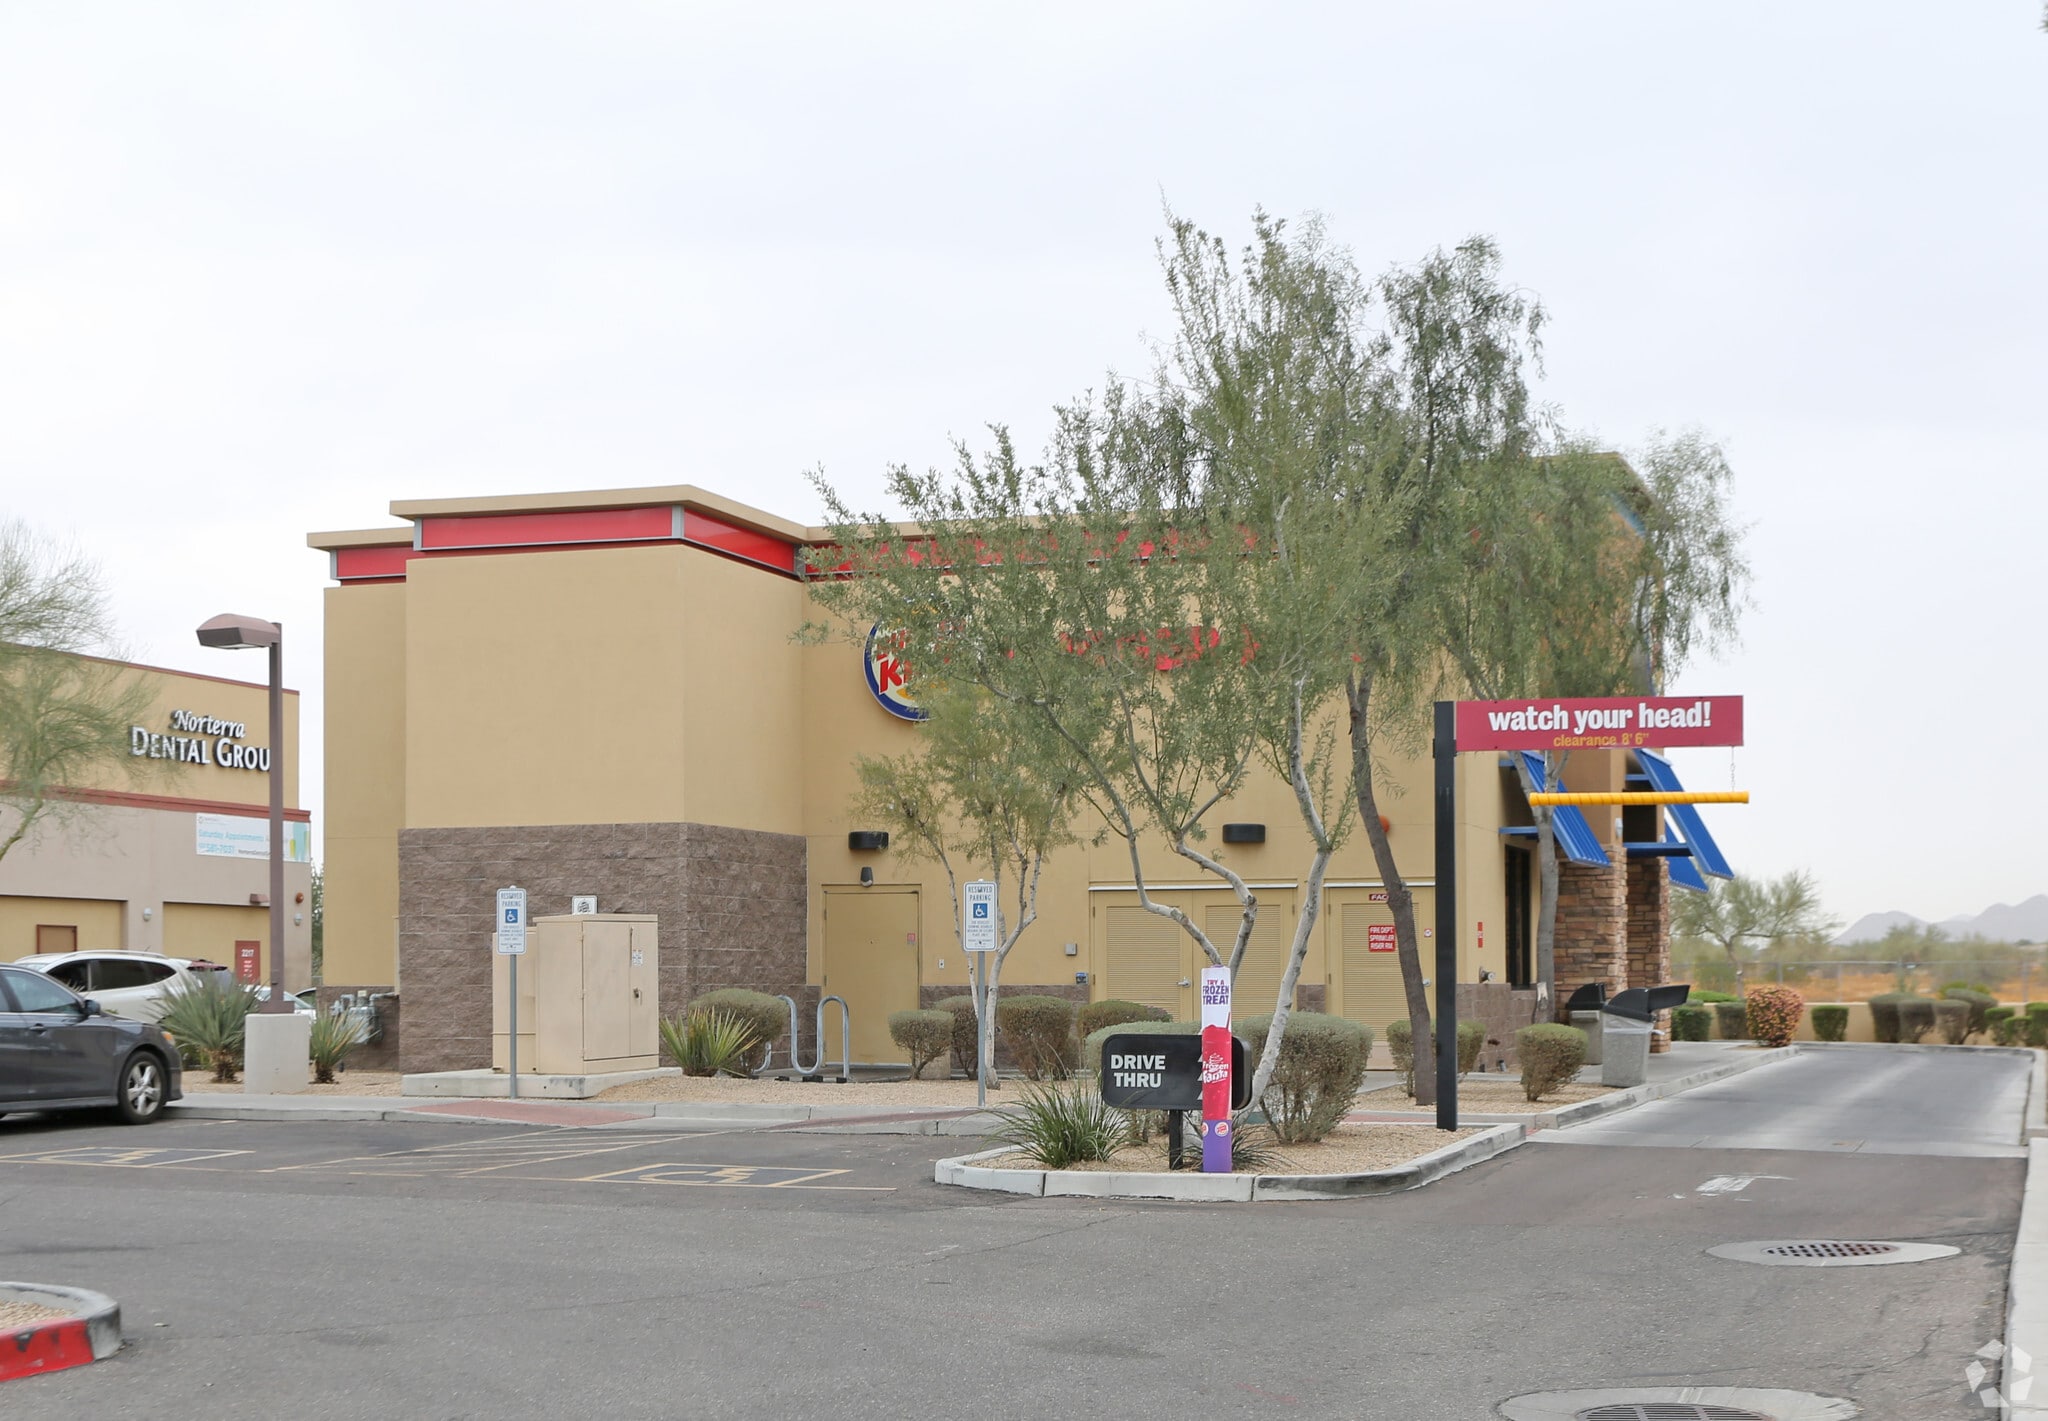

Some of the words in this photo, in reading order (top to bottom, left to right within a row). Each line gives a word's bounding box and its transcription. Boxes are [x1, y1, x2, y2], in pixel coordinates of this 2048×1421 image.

[173, 709, 246, 738] Norterra
[1488, 704, 1569, 731] watch
[1574, 709, 1633, 735] your
[1638, 701, 1712, 728] head!
[1553, 732, 1617, 747] clearance
[1622, 733, 1634, 745] 8'
[131, 726, 211, 764] DENTAL
[216, 737, 271, 772] GROU
[1203, 986, 1229, 995] FROZEN
[1203, 995, 1229, 1005] TREAT
[1111, 1055, 1165, 1070] DRIVE
[1113, 1073, 1162, 1088] THRU
